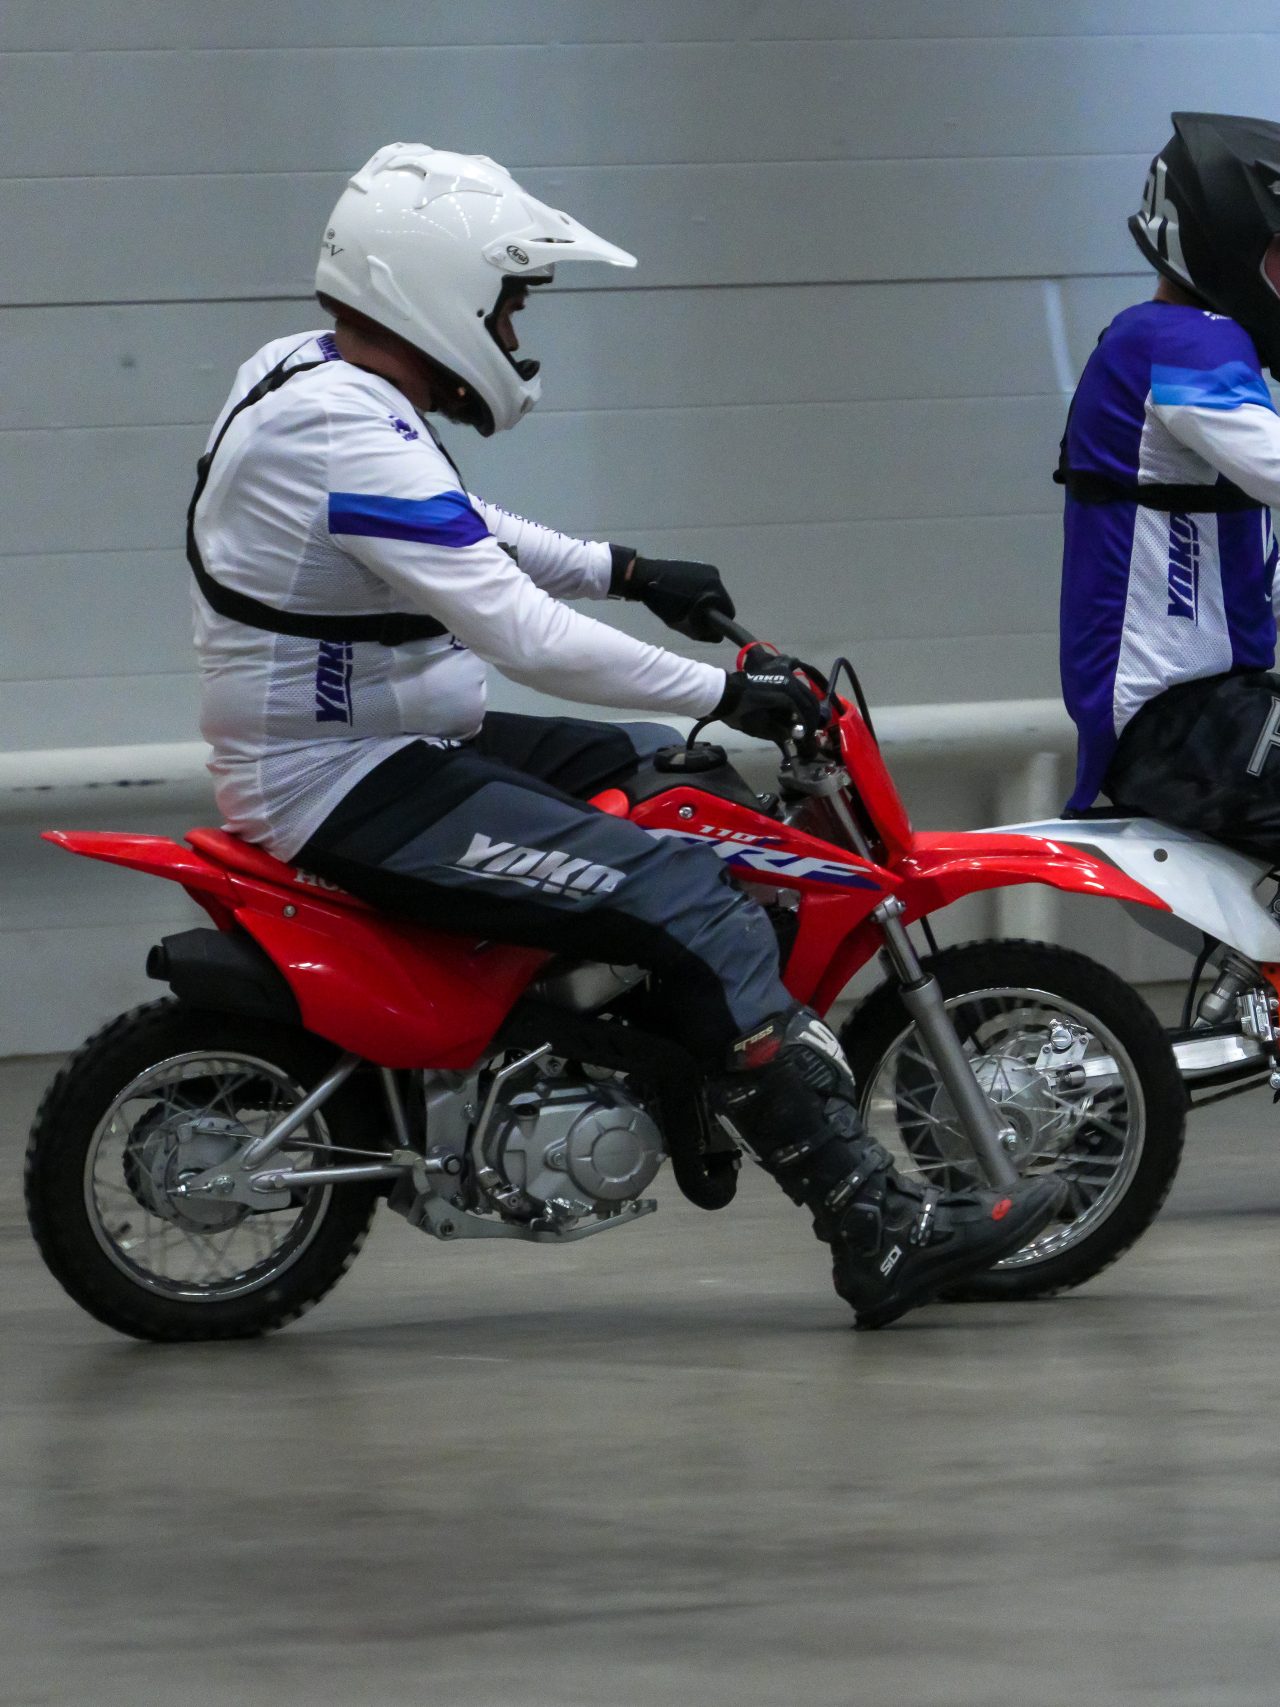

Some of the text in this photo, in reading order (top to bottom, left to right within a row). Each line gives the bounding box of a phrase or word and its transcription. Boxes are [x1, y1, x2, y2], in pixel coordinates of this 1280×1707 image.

[315, 639, 351, 723] YOK
[746, 672, 785, 684] YOKO
[450, 832, 627, 897] YOKO
